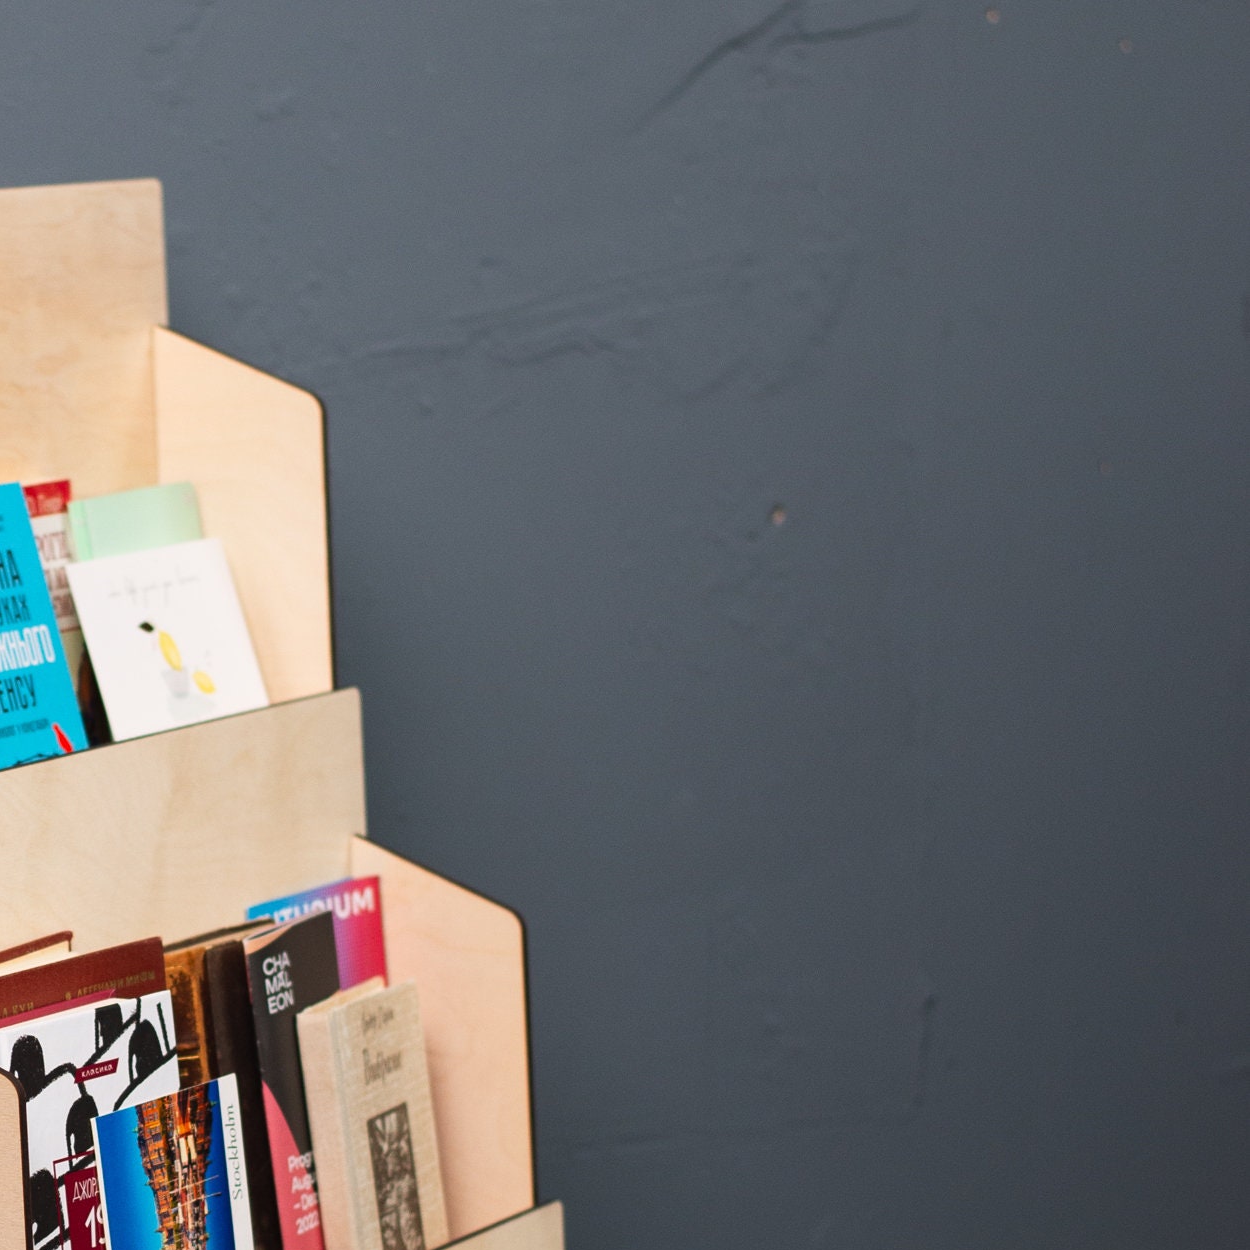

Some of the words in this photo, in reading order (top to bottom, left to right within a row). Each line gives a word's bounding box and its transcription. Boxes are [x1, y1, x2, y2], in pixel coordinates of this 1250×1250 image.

[262, 951, 291, 976] CHA
[268, 989, 295, 1015] EON
[225, 1104, 243, 1200] Stockholm
